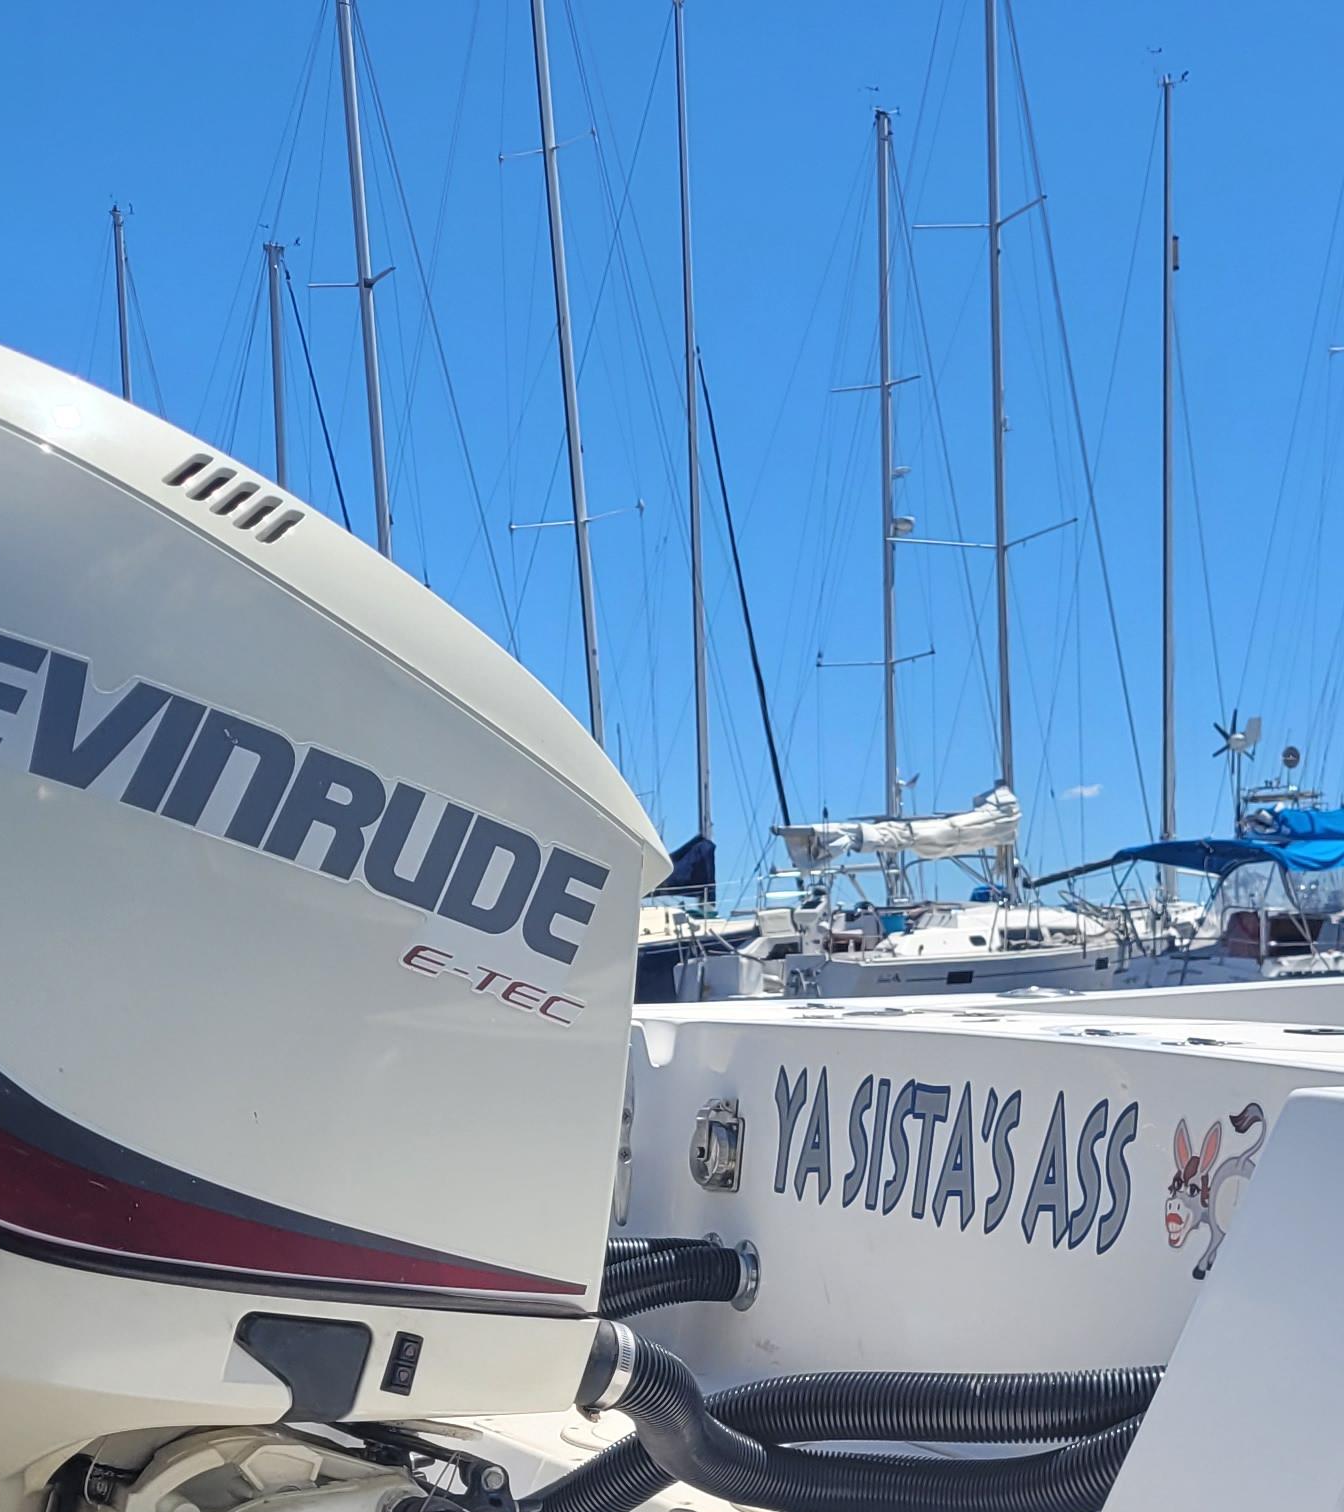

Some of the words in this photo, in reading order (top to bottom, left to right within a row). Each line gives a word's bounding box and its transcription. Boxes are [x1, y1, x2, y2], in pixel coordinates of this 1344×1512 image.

[402, 944, 586, 1026] E-TEC
[774, 1064, 831, 1205] YA
[841, 1072, 1022, 1234] SISTA'S
[1020, 1089, 1139, 1255] ASS
